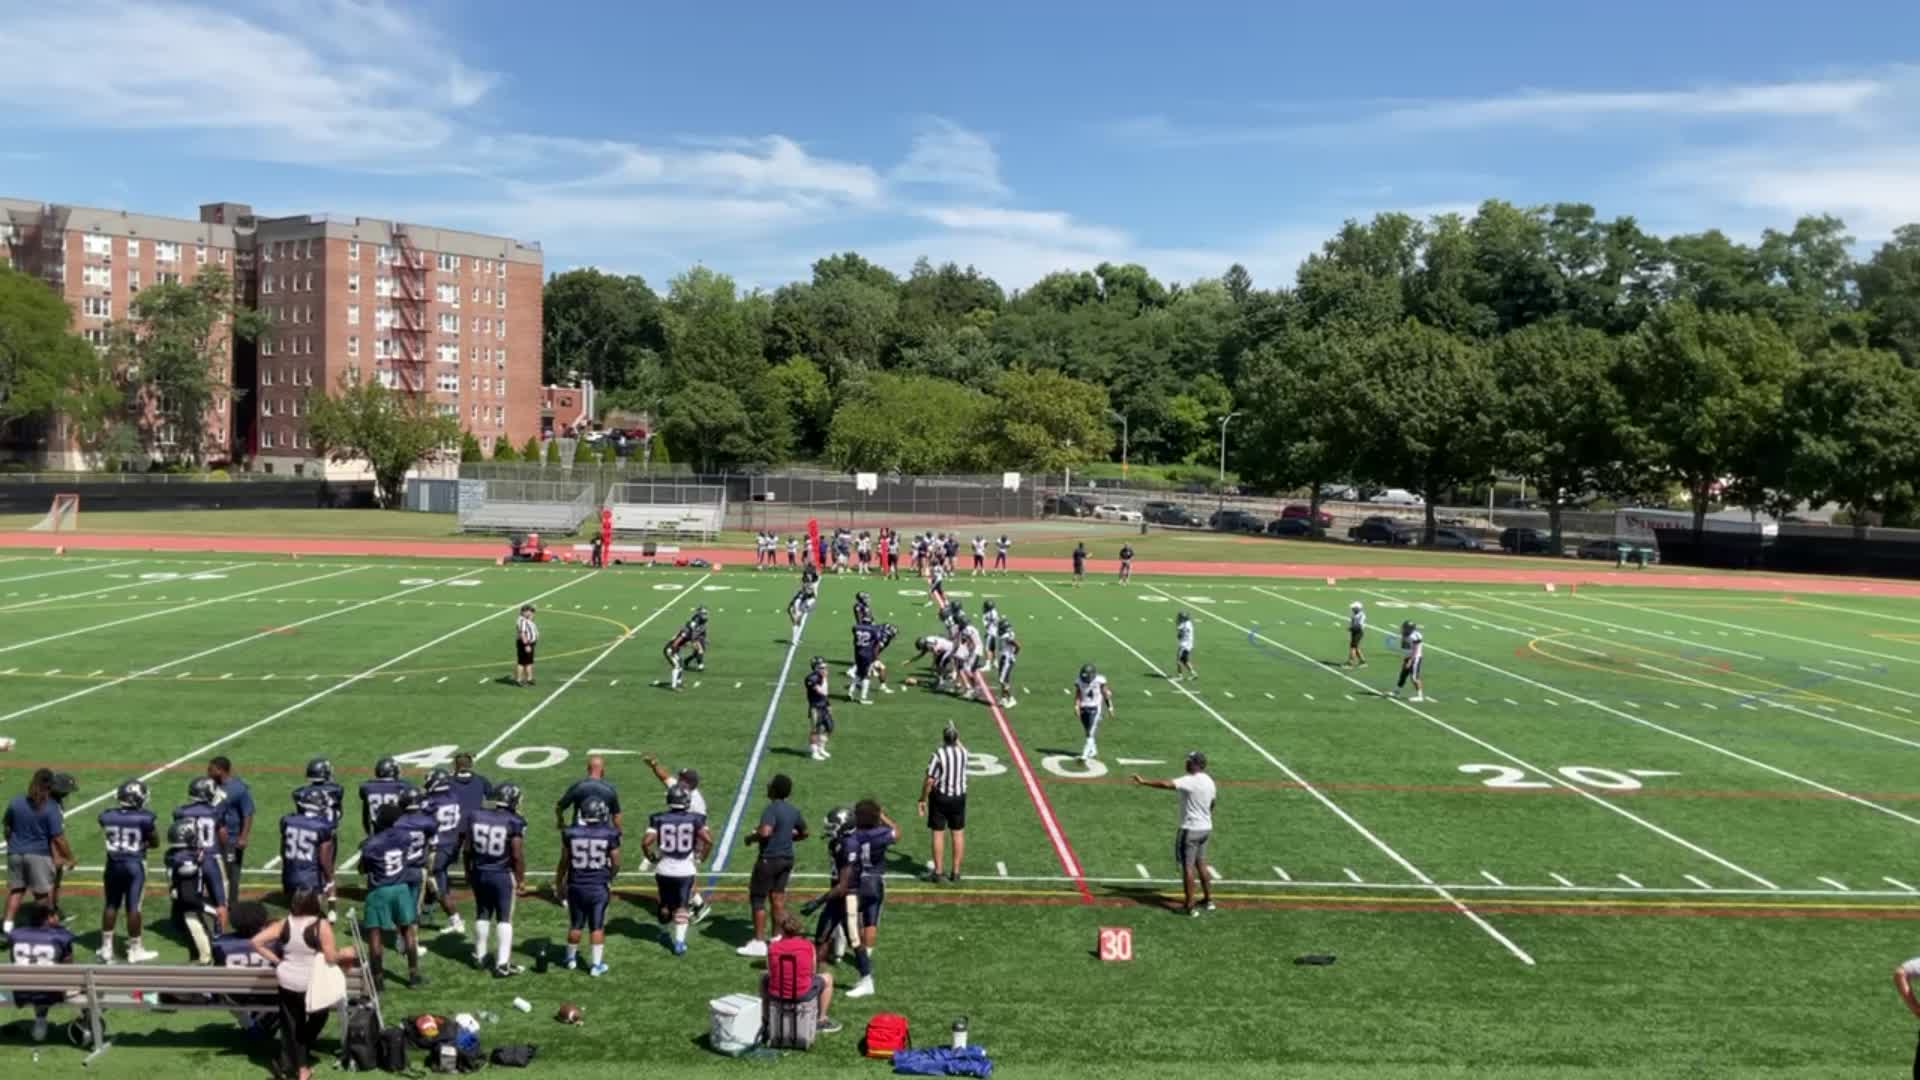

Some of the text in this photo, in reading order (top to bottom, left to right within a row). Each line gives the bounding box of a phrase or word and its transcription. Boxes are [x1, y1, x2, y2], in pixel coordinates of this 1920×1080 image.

[105, 826, 142, 852] 30
[284, 826, 318, 861] 35
[473, 824, 507, 856] 58
[660, 823, 694, 852] 66
[571, 839, 608, 869] 55
[1101, 930, 1132, 960] 30
